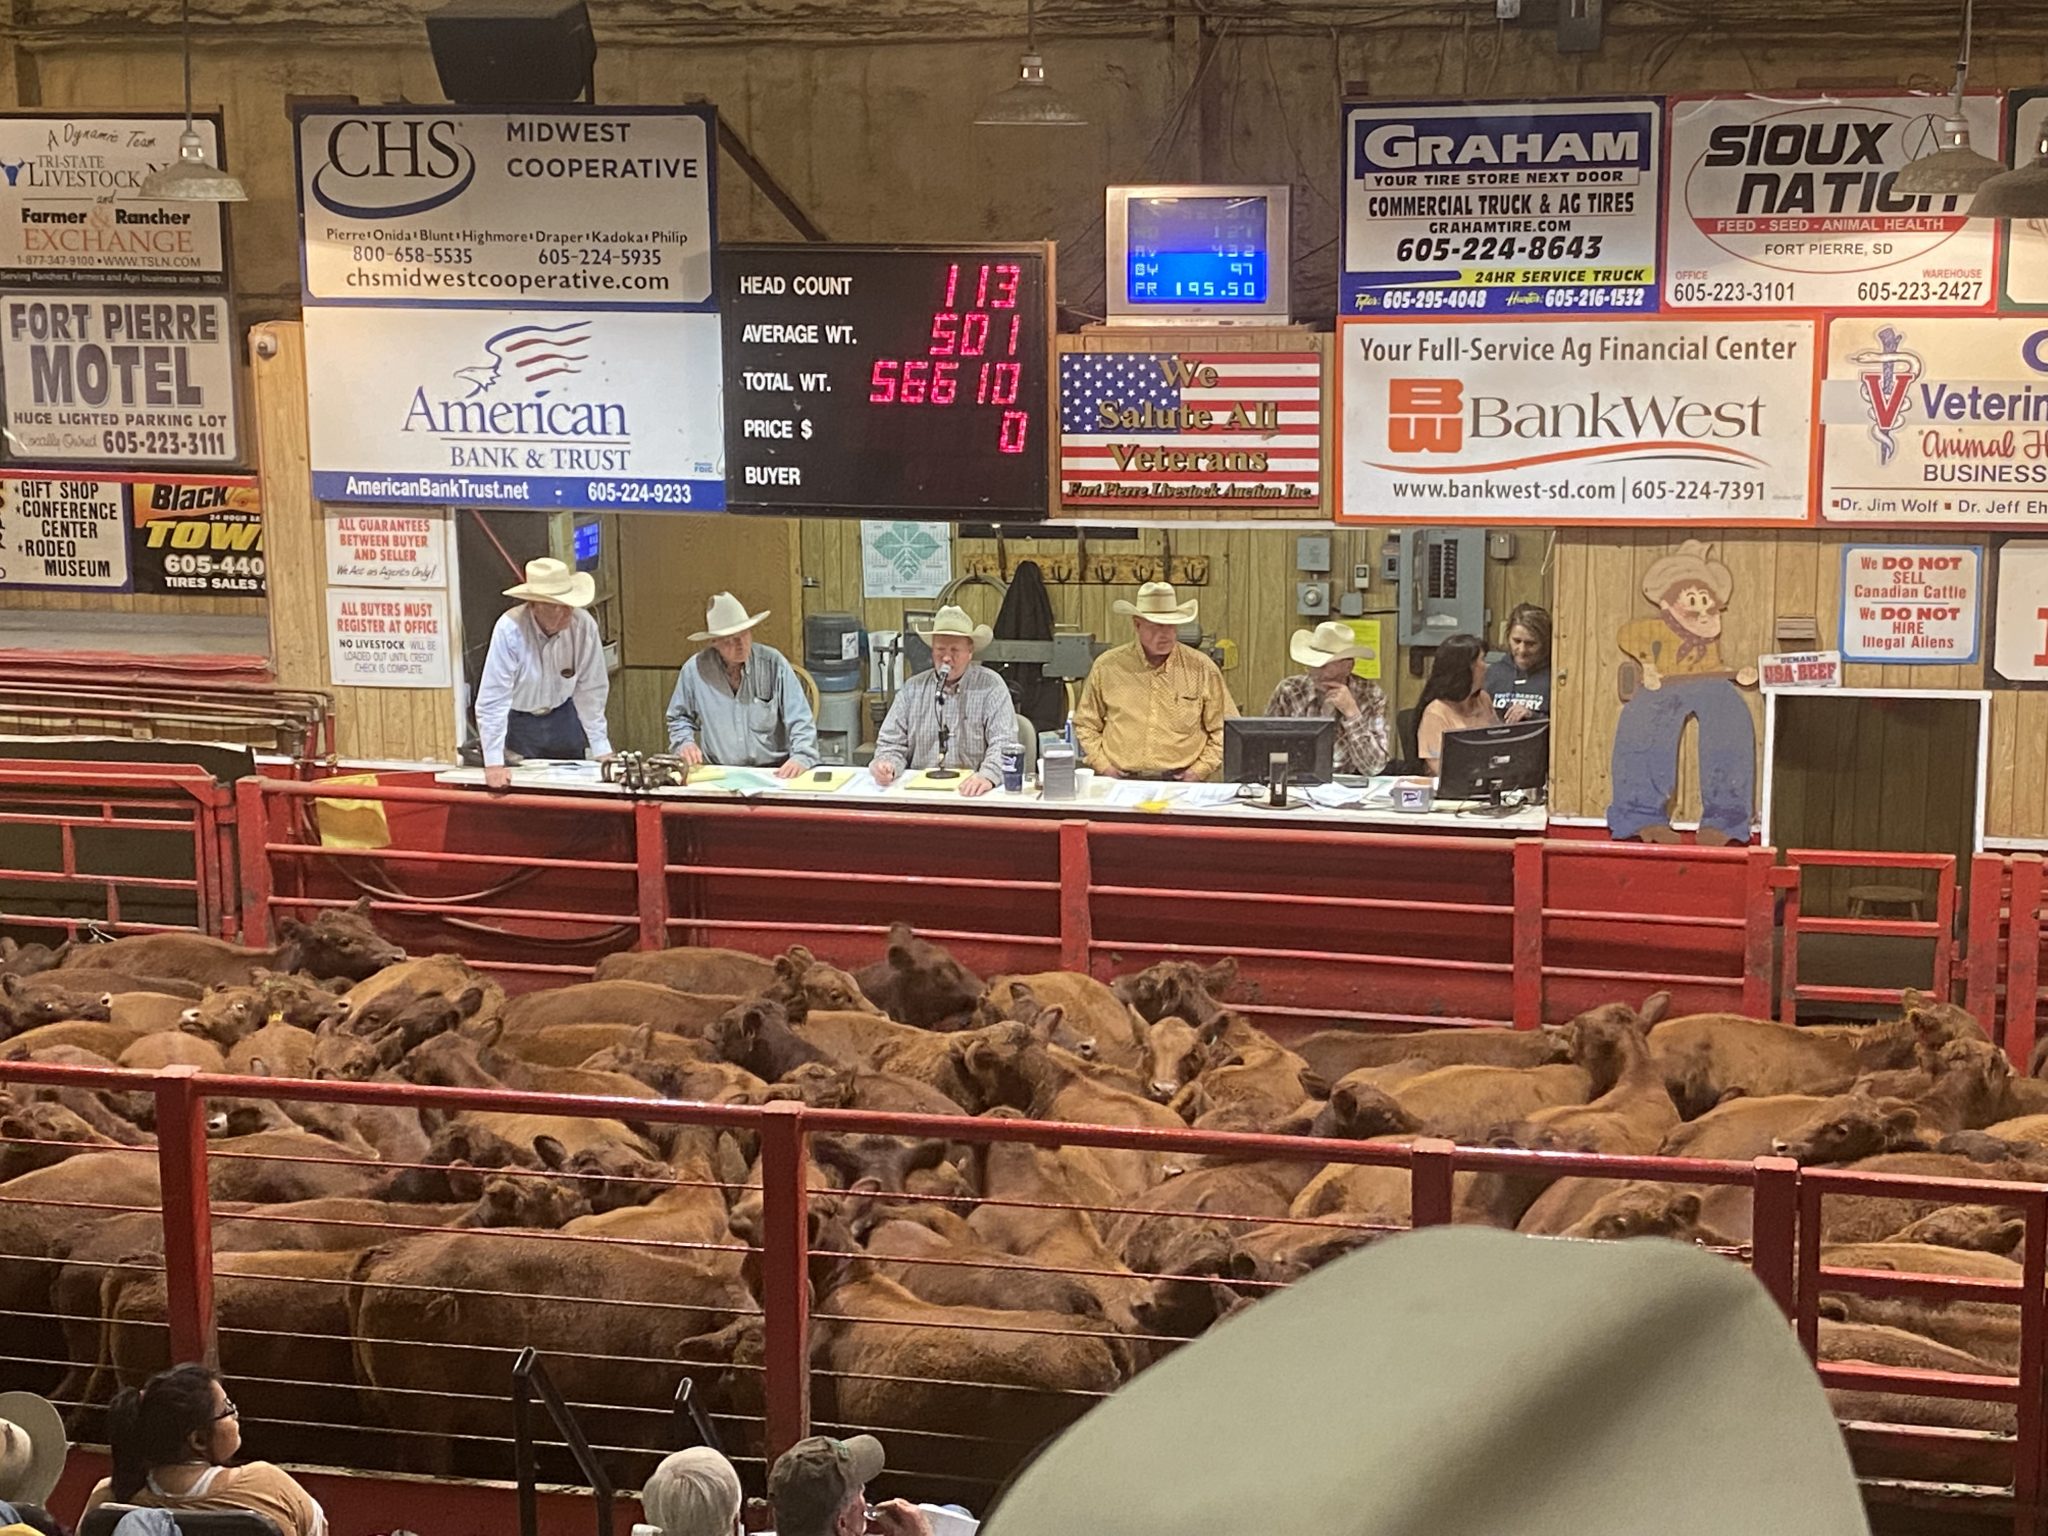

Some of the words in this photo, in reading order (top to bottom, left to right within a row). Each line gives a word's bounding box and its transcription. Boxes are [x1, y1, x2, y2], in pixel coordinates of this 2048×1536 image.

[48, 130, 58, 150] A
[64, 123, 118, 146] Dynamic
[126, 130, 156, 148] Team
[507, 122, 631, 143] MIDWEST
[327, 119, 460, 178] CHS
[1364, 124, 1639, 169] GRAHAM
[1705, 122, 1893, 167] SIOUX
[36, 155, 104, 169] TRI-STATE
[507, 157, 698, 179] COOPERATIVE
[28, 161, 141, 188] LIVESTOCK
[1374, 175, 1417, 187] YOUR
[1424, 174, 1460, 186] TIRE
[1467, 173, 1520, 185] STORE
[1526, 172, 1570, 184] NEXT
[1576, 171, 1623, 183] DOOR
[97, 190, 117, 204] and
[1369, 195, 1472, 217] COMMERCIAL
[1479, 194, 1531, 215] TRUCK
[1540, 194, 1550, 213] &
[1559, 193, 1581, 213] AG
[1588, 192, 1634, 213] TIRES
[21, 208, 87, 224] Farmer
[115, 208, 190, 225] Rancher
[1717, 220, 1756, 231] FEED
[1769, 220, 1810, 231] SEED
[1823, 219, 1880, 231] ANIMAL
[1885, 219, 1944, 231] HEALTH
[326, 227, 367, 242] Pierre
[373, 228, 411, 242] Onida
[420, 228, 454, 243] Blunt
[462, 229, 528, 246] Highmore
[536, 230, 584, 246] Draper
[591, 230, 643, 244] Kadoka
[652, 230, 688, 246] Philip
[1429, 220, 1571, 234] GRAHAMTIRE.COM
[24, 228, 193, 252] EXCHANGE
[1397, 236, 1603, 261] 605-224-8643
[353, 246, 473, 264] 800-658-5535
[538, 248, 662, 266] 605-224-5935
[1212, 244, 1255, 257] 432
[1764, 244, 1804, 256] FORT
[1809, 243, 1867, 257] PIERRE,
[1873, 243, 1893, 255] SD
[17, 255, 94, 266] 1-877-347-9100
[103, 256, 200, 268] WWW.TSLN.COM
[1231, 263, 1253, 276] 97
[346, 267, 669, 295] chsmidwestcooperative.com
[1475, 271, 1515, 284] 24HR
[1521, 270, 1586, 283] SERVICE
[1592, 269, 1645, 282] TRUCK
[1676, 271, 1708, 280] OFFICE
[1922, 269, 1982, 279] WAREHOUSE
[740, 276, 786, 294] HEAD
[793, 277, 852, 295] COUNT
[945, 264, 1021, 308] 113
[1135, 282, 1158, 296] PR
[1176, 282, 1255, 296] 195.50
[1674, 282, 1795, 301] 605-223-3101
[1857, 281, 1983, 301] 605-223-2427
[1383, 290, 1487, 309] 605-295-4048
[1544, 288, 1643, 308] 605-216-1532
[10, 303, 91, 340] FORT
[103, 304, 218, 342] PIERRE
[742, 325, 818, 343] AVERAGE
[825, 325, 857, 344] WT.
[929, 313, 1020, 356] 501
[1360, 338, 1411, 362] Your
[1418, 336, 1554, 361] Full-Service
[1561, 337, 1591, 367] Ag
[1600, 336, 1708, 360] Financial
[1716, 336, 1797, 360] Center
[30, 344, 203, 407] MOTEL
[743, 372, 793, 391] TOTAL
[800, 373, 831, 392] WT.
[869, 361, 1021, 404] 56610
[1159, 360, 1219, 388] We
[14, 412, 52, 425] HUGE
[59, 413, 118, 426] LIGHTED
[126, 414, 192, 427] PARKING
[200, 415, 226, 427] LOT
[401, 385, 631, 436] American
[1099, 400, 1213, 430] Salute
[1224, 401, 1278, 430] All
[1469, 391, 1767, 440] BankWest
[744, 420, 792, 438] PRICE
[800, 419, 813, 440] $
[998, 410, 1029, 454] 0
[103, 431, 225, 455] 605-223-3111
[450, 446, 518, 469] BANK
[526, 447, 544, 469] &
[550, 448, 631, 472] TRUST
[1106, 443, 1269, 473] Veterans
[745, 467, 800, 485] BUYER
[1923, 465, 2046, 483] BUSINESS
[21, 481, 52, 498] GIFT
[60, 482, 99, 499] SHOP
[346, 476, 529, 500] AmericanBankTrust.net
[588, 483, 692, 503] 605-224-9233
[1067, 482, 1101, 498] Fort
[1102, 483, 1149, 498] Pierre
[1151, 483, 1220, 498] Livestock
[1221, 483, 1282, 499] Auction
[1283, 484, 1313, 499] Inc.
[1393, 479, 1616, 501] www.bankwest-sd.com
[1631, 480, 1765, 501] 605-224-7391
[23, 501, 118, 520] CONFERENCE
[1840, 498, 1862, 511] Dr.
[1867, 499, 1896, 512] Jim
[1902, 499, 1938, 512] Wolf
[1958, 500, 1981, 513] Dr.
[1986, 501, 2020, 513] Jeff
[42, 520, 98, 538] CENTER
[338, 518, 356, 531] ALL
[359, 519, 430, 532] GUARANTEES
[25, 540, 76, 557] RODEO
[340, 534, 389, 547] BETWEEN
[392, 535, 428, 547] BUYER
[354, 549, 376, 560] AND
[380, 550, 416, 561] SELLER
[1861, 557, 1877, 570] We
[1882, 557, 1913, 570] DO
[1919, 557, 1962, 570] NOT
[45, 560, 110, 577] MUSEUM
[1893, 571, 1926, 584] SELL
[165, 577, 207, 588] TIRES
[212, 578, 258, 590] SALES
[1854, 585, 1919, 599] Canadian
[1924, 585, 1967, 600] Cattle
[341, 602, 358, 615] ALL
[361, 603, 400, 616] BUYERS
[404, 603, 433, 617] MUST
[1859, 607, 1876, 620] We
[1880, 607, 1911, 621] DO
[1917, 607, 1961, 621] NOT
[337, 619, 385, 633] REGISTER
[389, 620, 401, 633] AT
[404, 621, 438, 634] OFFICE
[1892, 621, 1925, 635] HIRE
[339, 639, 353, 648] NO
[356, 640, 405, 649] LIVESTOCK
[1862, 635, 1905, 650] Illegal
[1911, 635, 1954, 649] Aliens
[1797, 662, 1837, 681] BEEF
